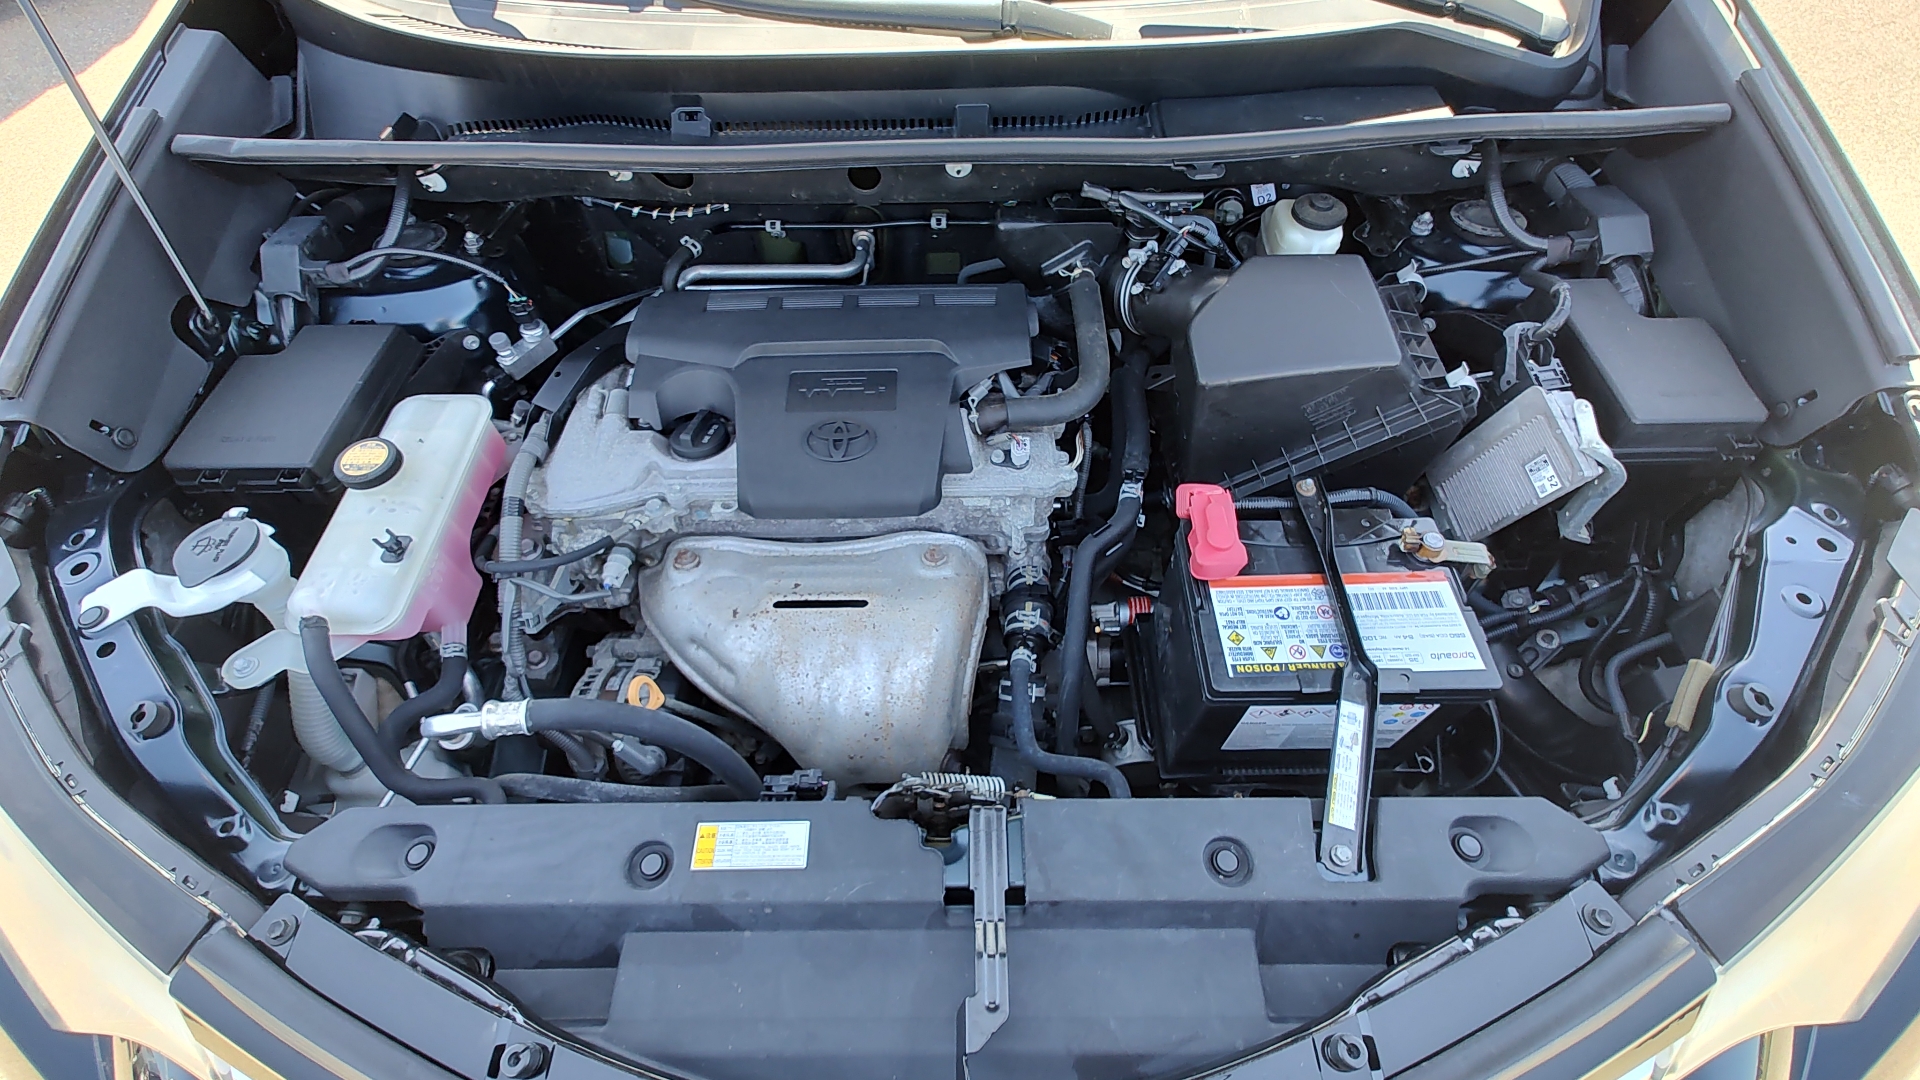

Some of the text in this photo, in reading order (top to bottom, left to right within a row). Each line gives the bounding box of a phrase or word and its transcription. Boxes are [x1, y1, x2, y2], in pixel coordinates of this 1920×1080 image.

[1257, 193, 1272, 205] D2
[1547, 475, 1558, 488] 52
[1430, 651, 1476, 661] bproauto
[1236, 664, 1280, 673] POISON
